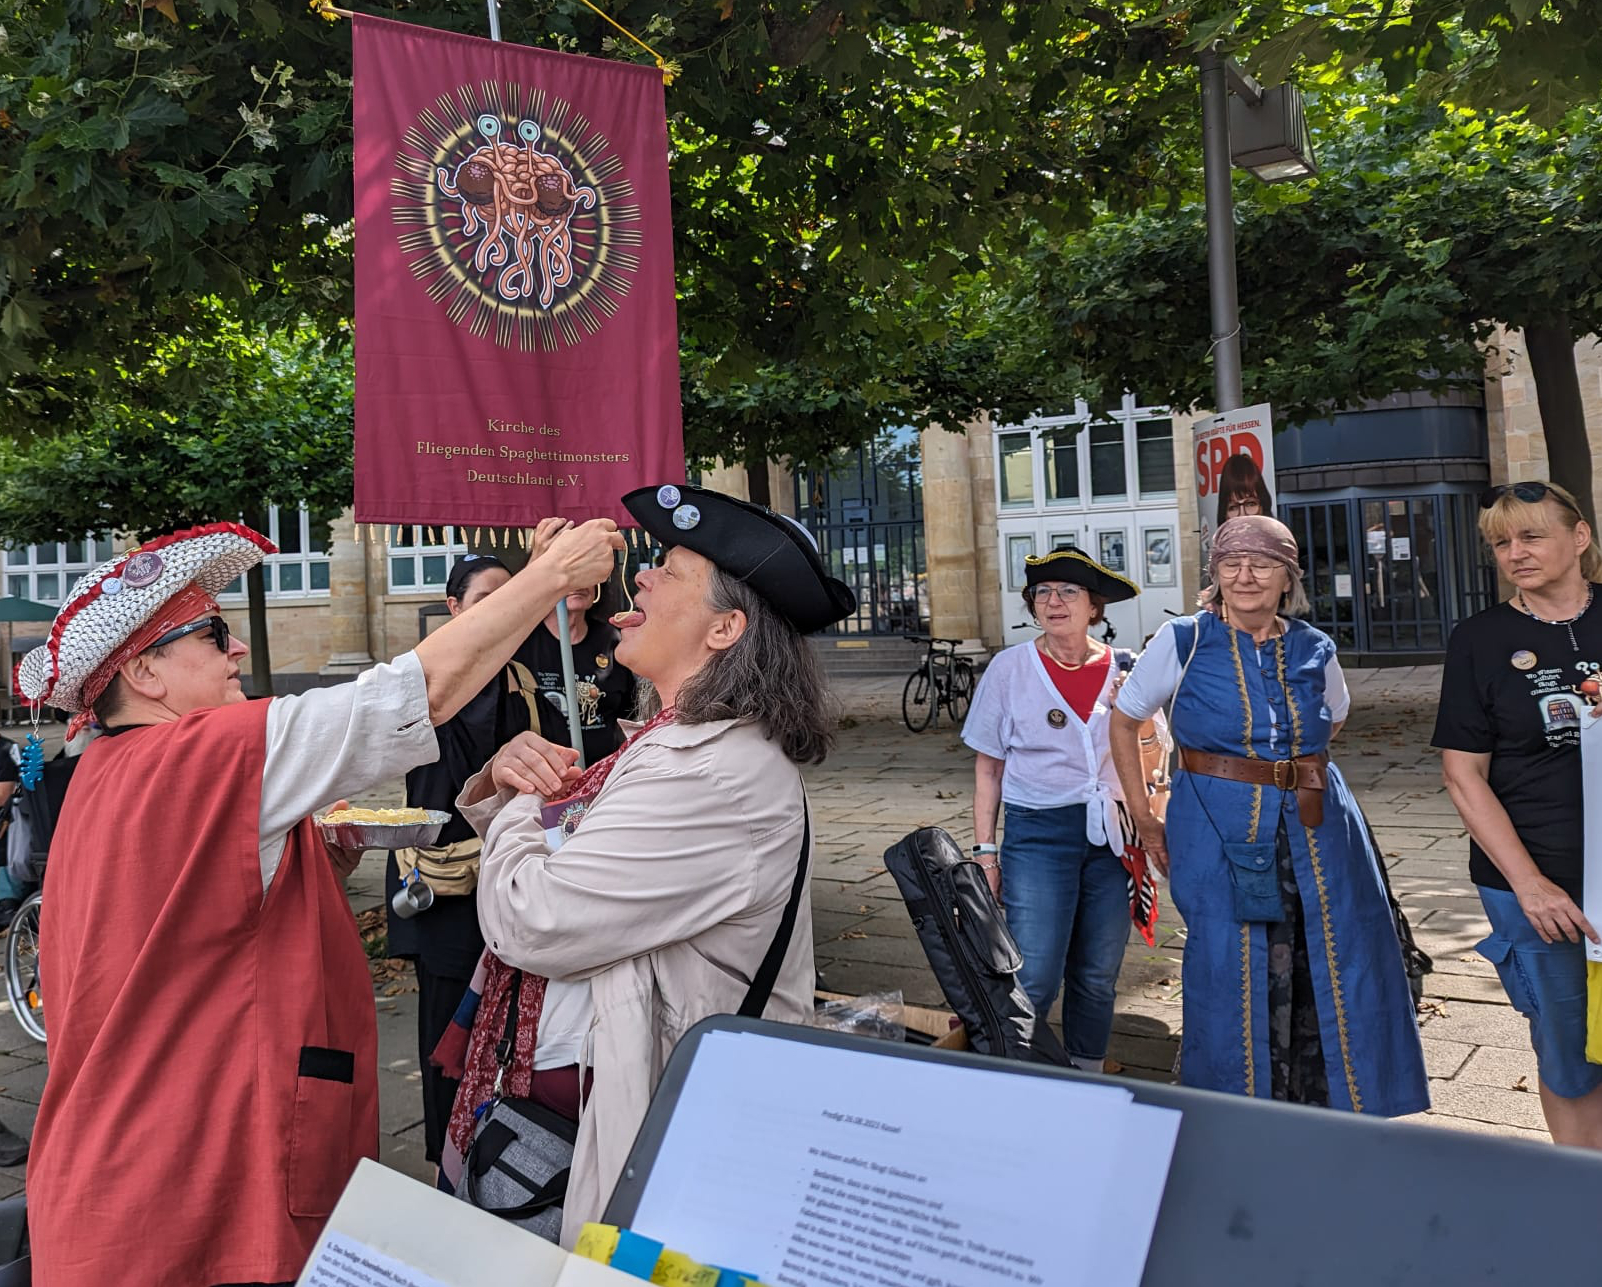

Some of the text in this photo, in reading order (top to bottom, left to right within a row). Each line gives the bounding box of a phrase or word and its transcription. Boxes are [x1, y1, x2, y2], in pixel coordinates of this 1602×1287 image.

[487, 418, 561, 437] Kirche des
[1225, 422, 1236, 433] FÜR
[416, 441, 630, 464] Fliegenden Spaghettimonsters
[1197, 432, 1264, 497] SPD
[467, 469, 585, 487] Deutschland e.V.
